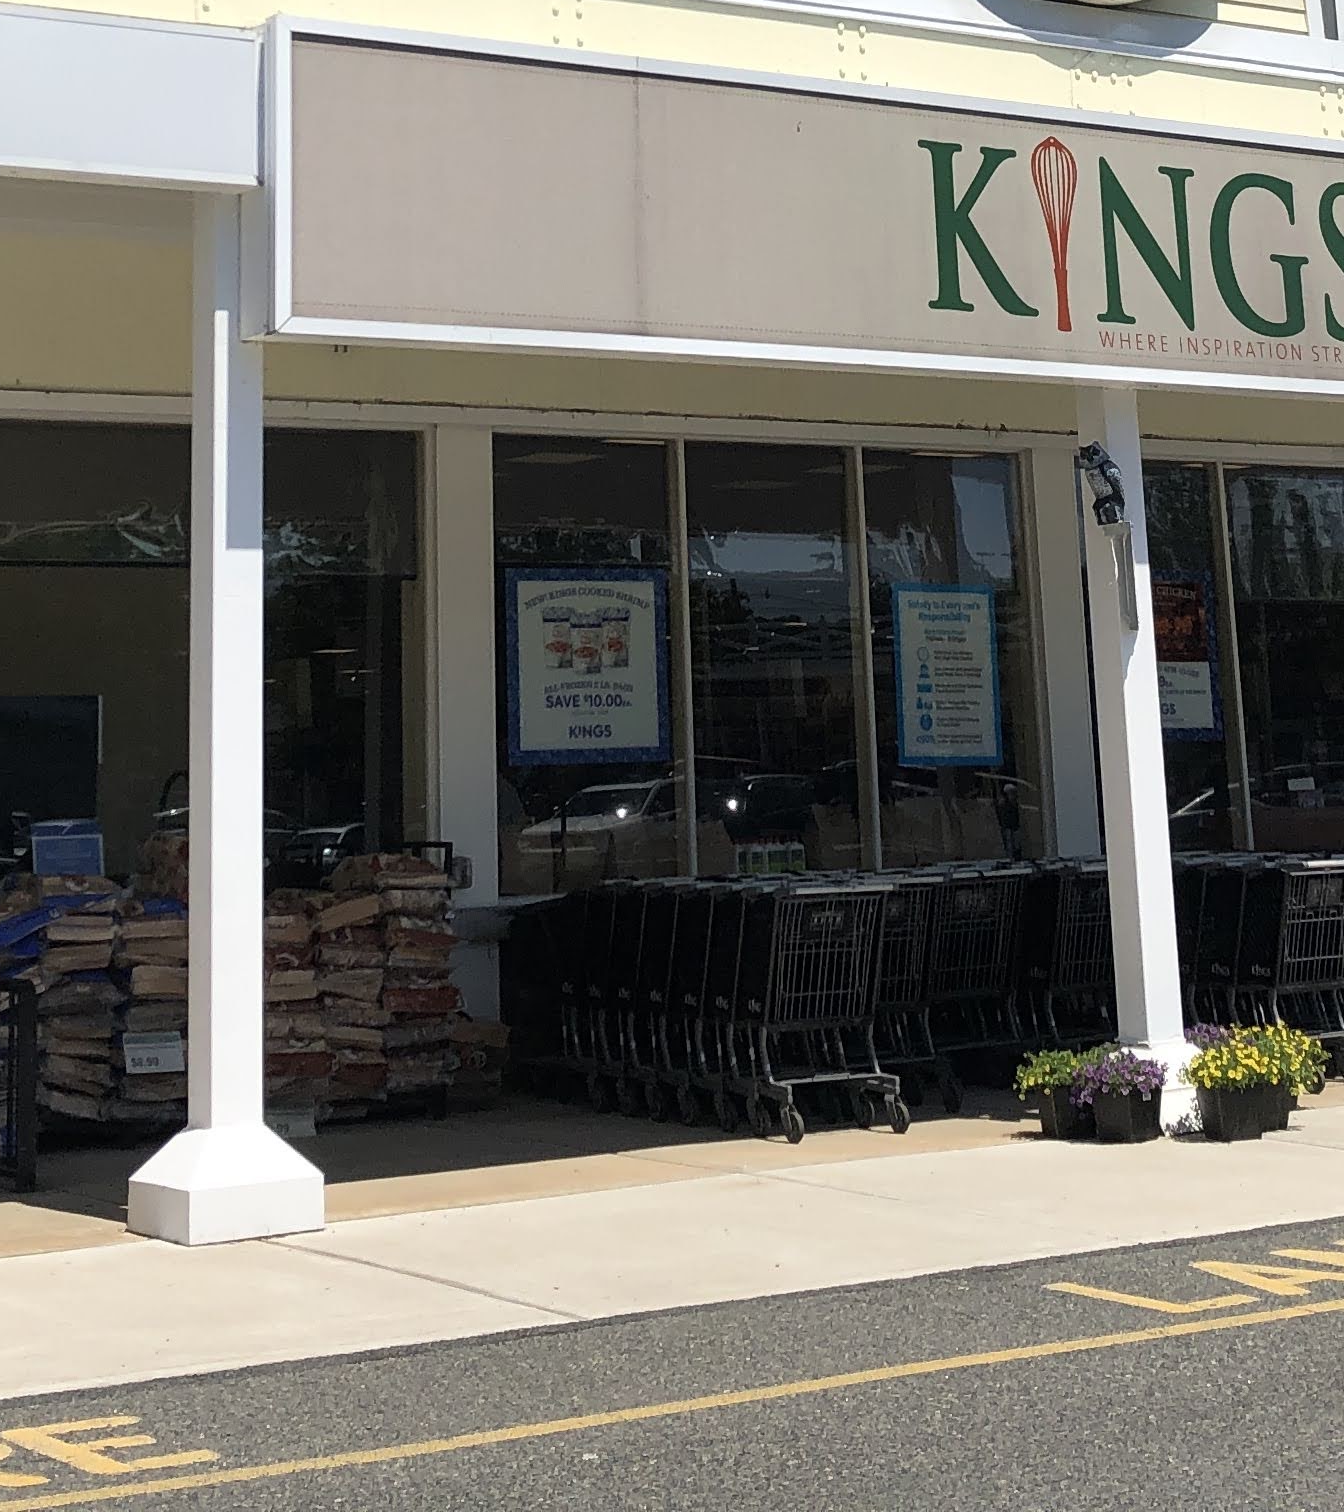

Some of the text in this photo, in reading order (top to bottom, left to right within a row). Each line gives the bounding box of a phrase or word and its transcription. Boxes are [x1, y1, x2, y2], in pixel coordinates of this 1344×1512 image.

[1098, 330, 1169, 354] WHERE
[1178, 336, 1304, 361] INSPIRATION
[545, 693, 580, 709] SAVE
[568, 723, 612, 739] KINGS
